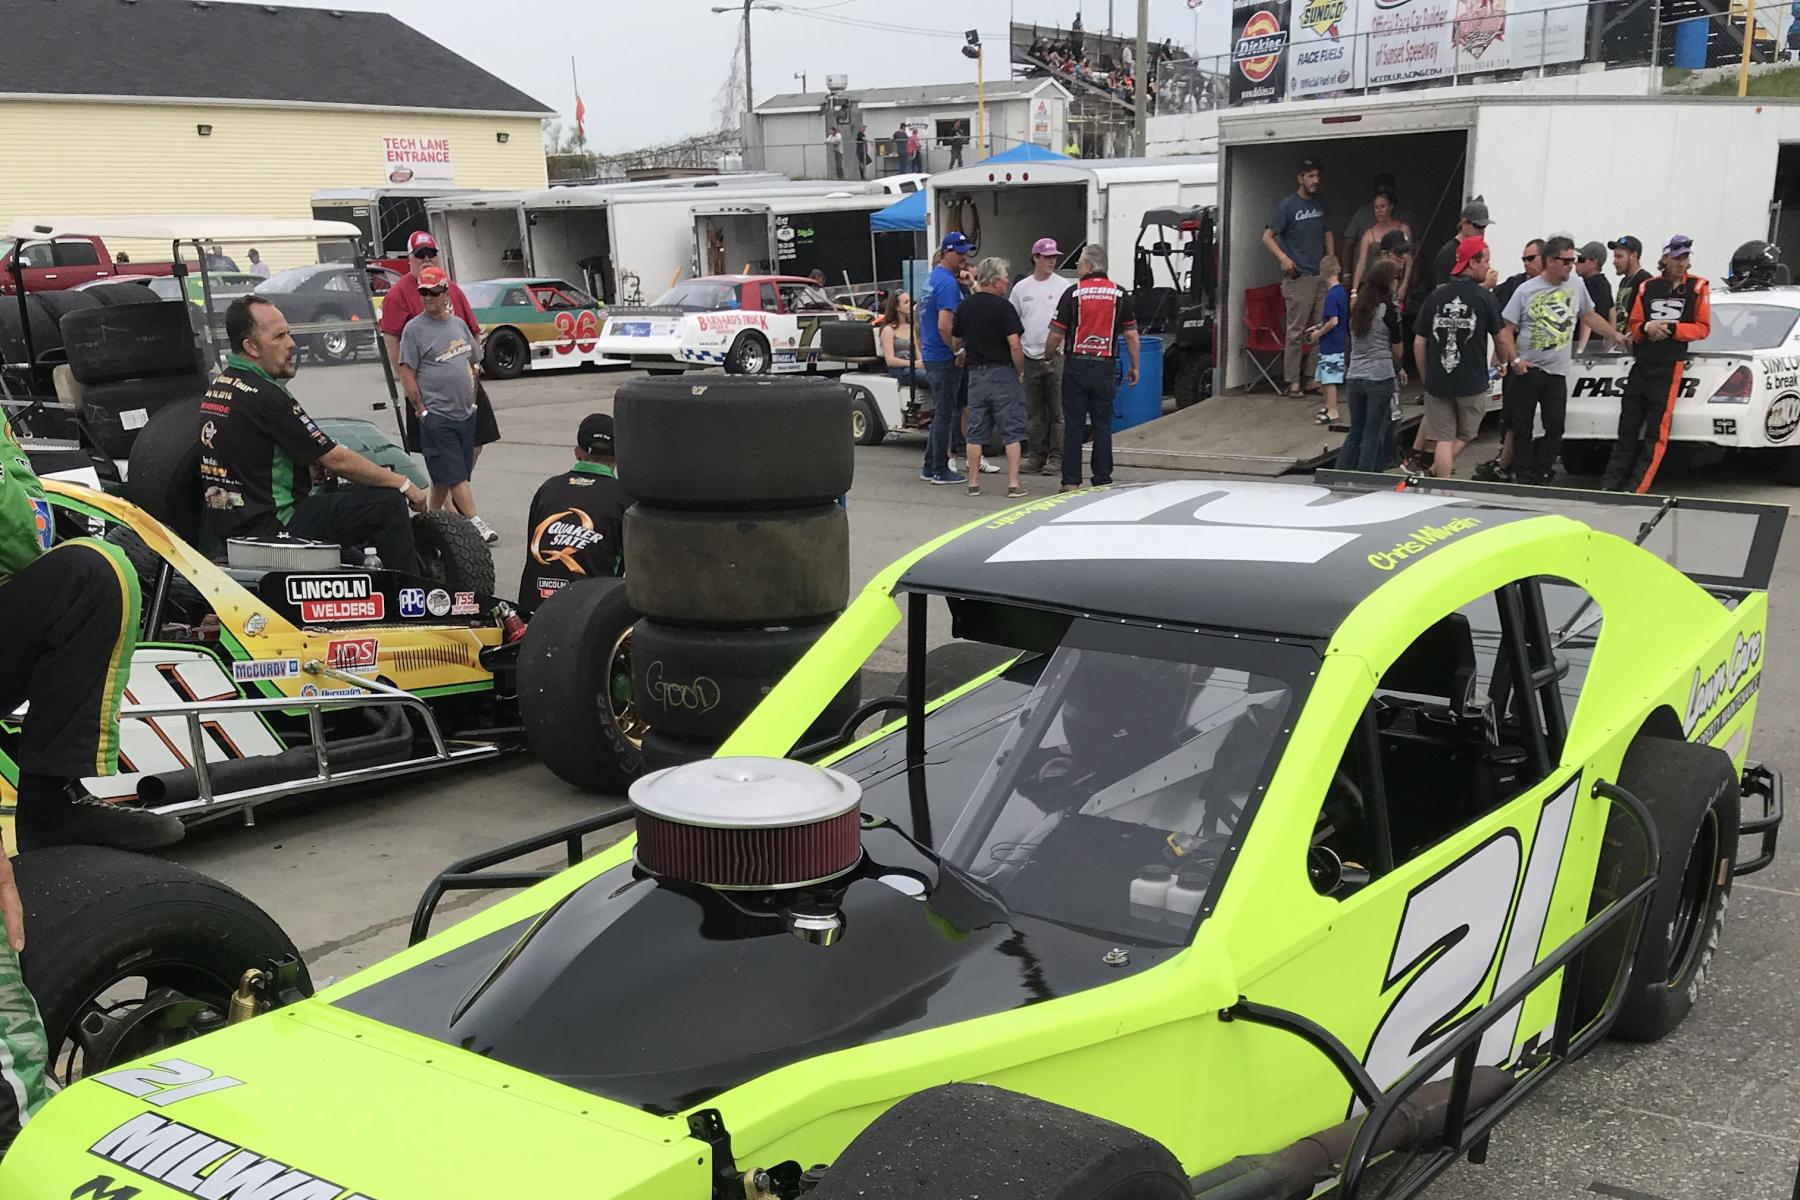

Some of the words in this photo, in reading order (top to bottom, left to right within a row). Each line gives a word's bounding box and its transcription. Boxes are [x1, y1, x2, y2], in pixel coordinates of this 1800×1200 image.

[1303, 2, 1343, 24] SUNOCO
[1238, 37, 1282, 57] Dickies
[1298, 50, 1319, 65] RACE
[1320, 47, 1344, 62] FUELS
[383, 138, 416, 149] TECH
[420, 139, 449, 150] LANE
[387, 151, 450, 163] ENTRANCE
[555, 310, 597, 355] 36
[697, 316, 741, 331] BARNARD'S
[743, 315, 769, 330] TRUCK
[1766, 376, 1772, 390] &
[1713, 419, 1737, 435] 52
[548, 521, 603, 544] QUAKER
[550, 534, 591, 549] STATE
[1367, 540, 1426, 571] Chris
[1409, 515, 1483, 546] Milwain
[291, 580, 367, 600] LINCOLN
[311, 602, 376, 616] WELDERS
[401, 590, 424, 612] PPG
[236, 662, 286, 680] McCURDY
[646, 660, 721, 715] GOOD
[1345, 766, 1584, 1122] 21
[91, 1058, 248, 1107] 21
